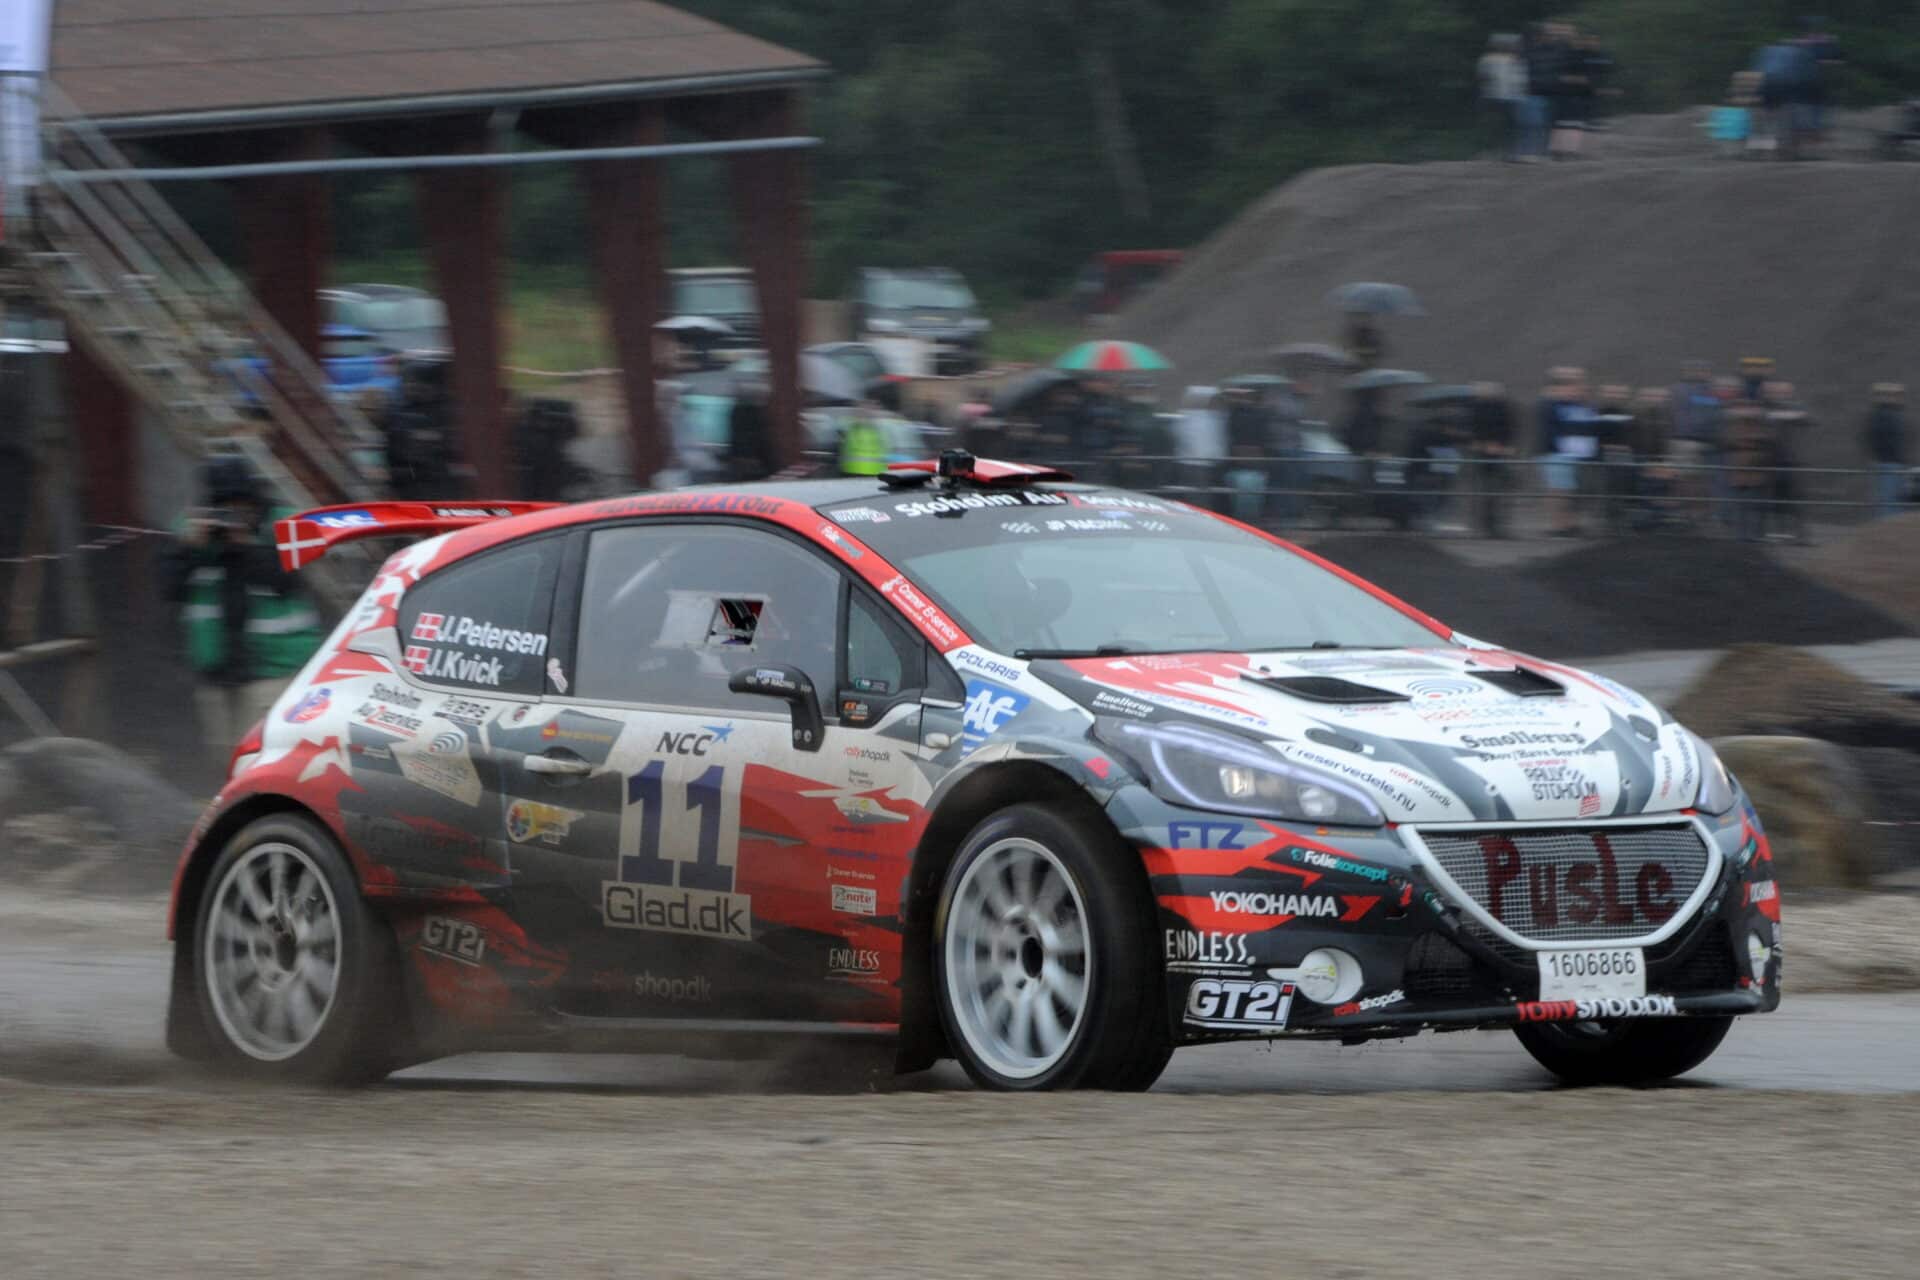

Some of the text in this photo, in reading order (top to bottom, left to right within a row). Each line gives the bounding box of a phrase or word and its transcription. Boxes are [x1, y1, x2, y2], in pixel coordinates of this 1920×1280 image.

[894, 492, 1022, 518] Stoholm
[436, 615, 548, 656] J.Petersen
[424, 648, 504, 686] J.Kvick
[956, 650, 1022, 681] POLARIS
[655, 731, 713, 757] NCC
[621, 760, 734, 893] 11
[1168, 821, 1246, 850] FTZ
[606, 886, 747, 936] Glad.dk
[1210, 891, 1339, 917] YOKOHAMA
[829, 947, 881, 971] ENDLESS
[1549, 951, 1637, 977] 1606866
[1186, 980, 1297, 1022] GT2i
